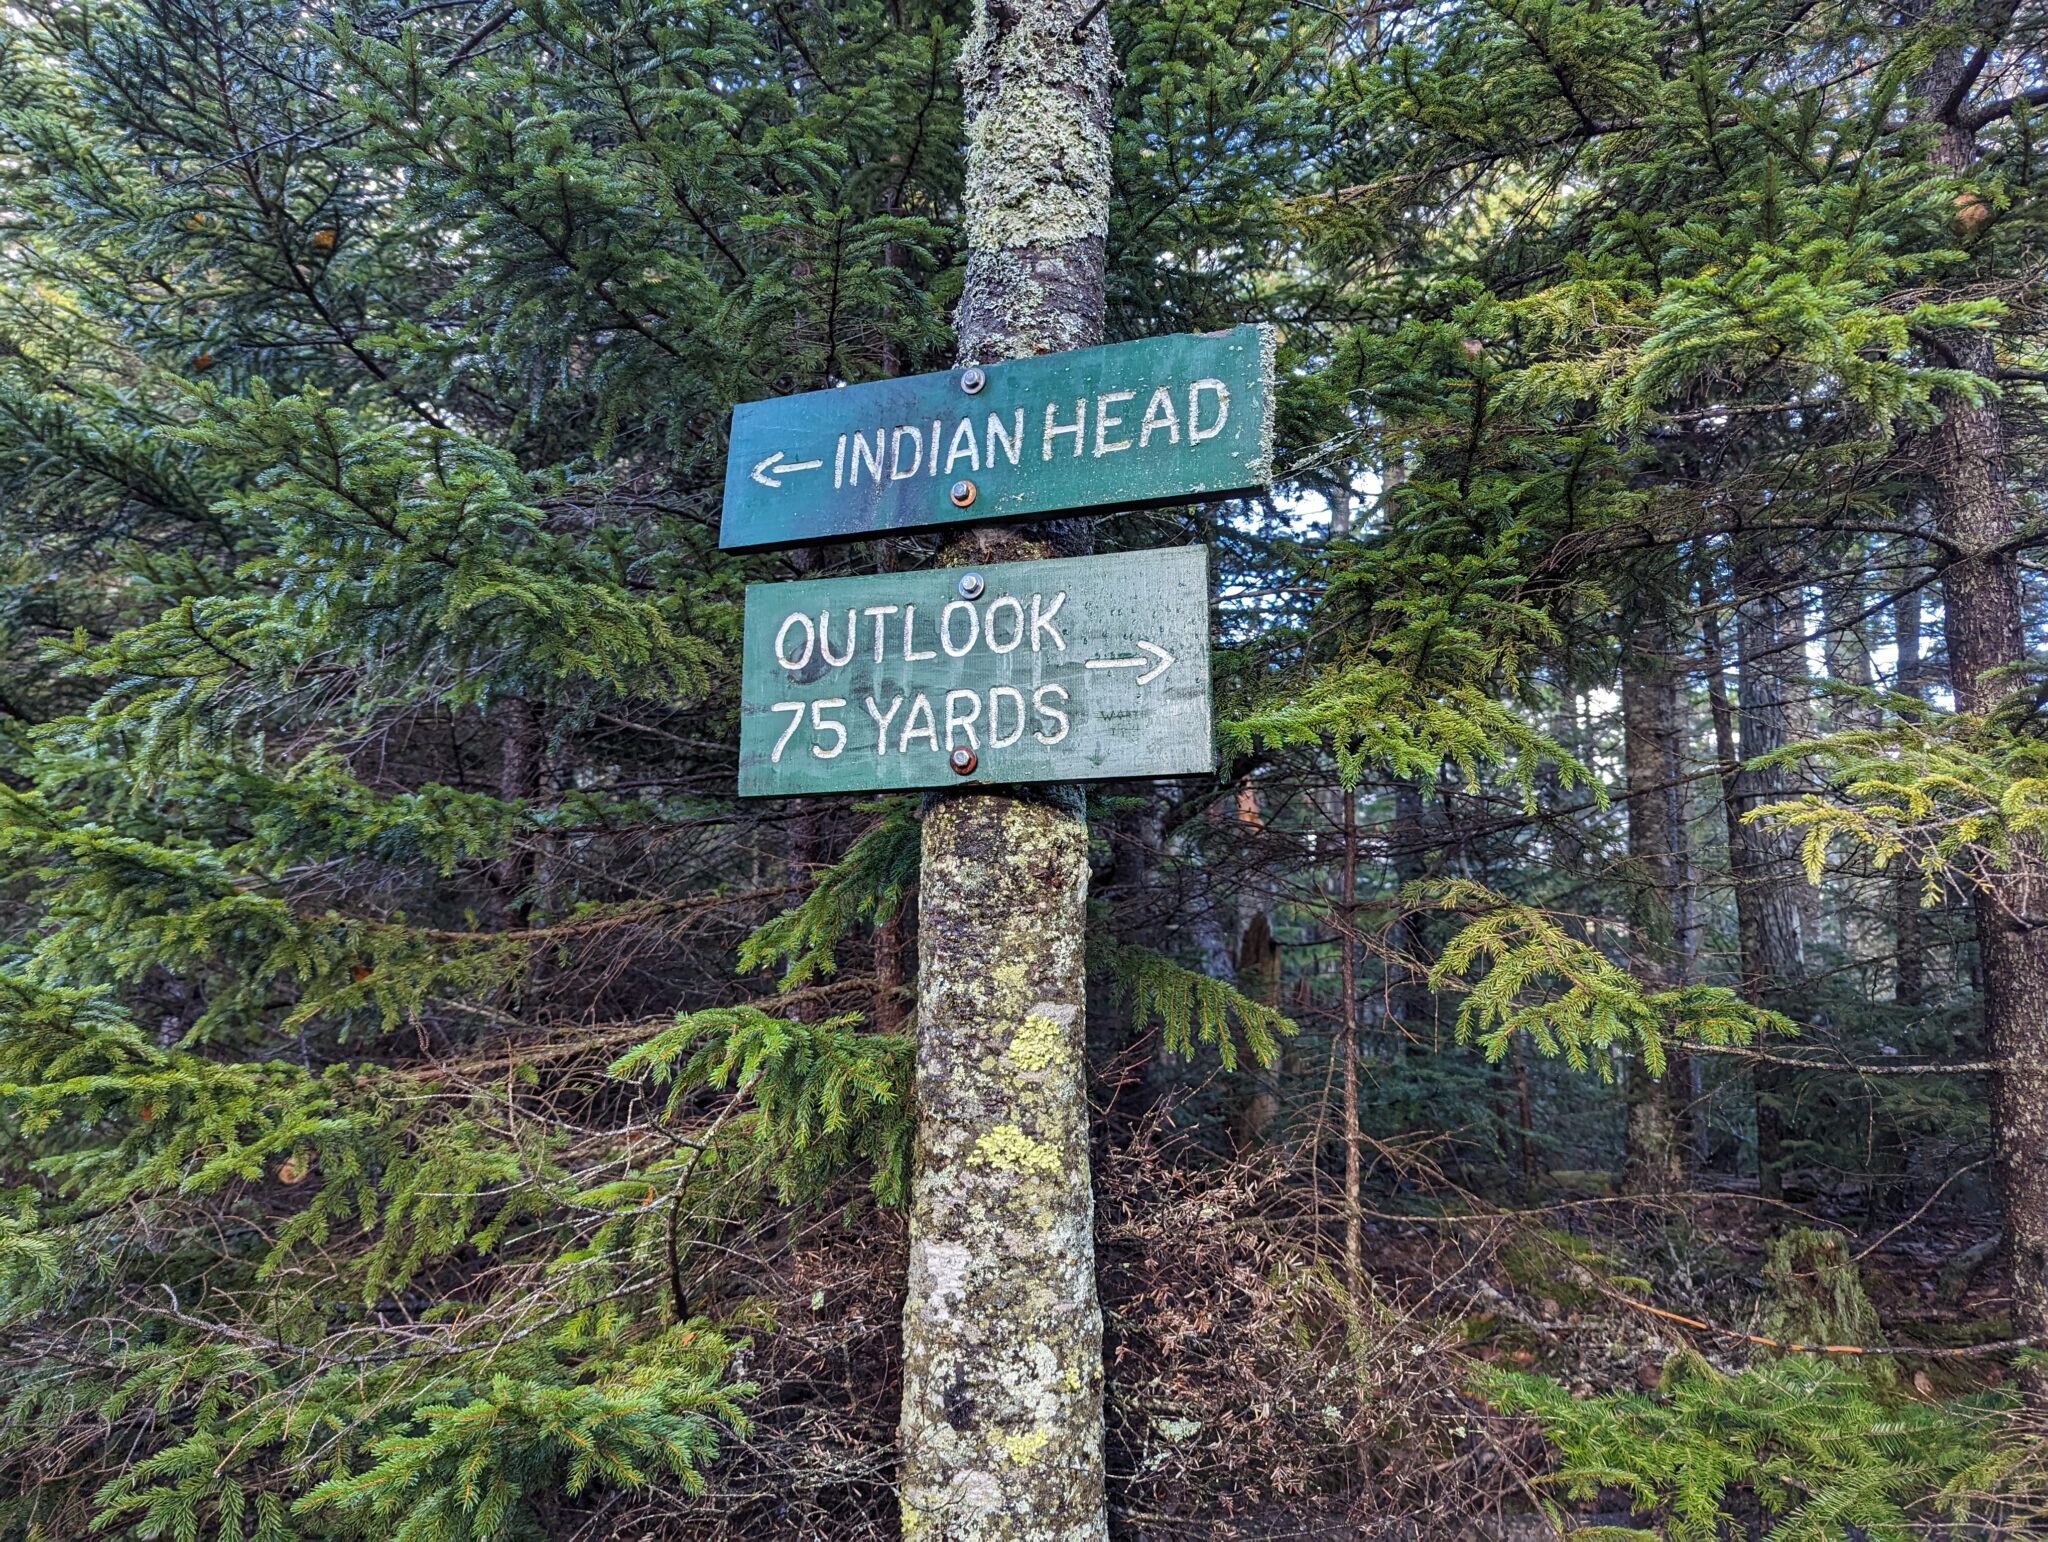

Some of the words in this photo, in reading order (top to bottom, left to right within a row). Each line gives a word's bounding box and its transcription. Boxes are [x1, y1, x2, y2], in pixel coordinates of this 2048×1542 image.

[834, 408, 1025, 488] INDIAN
[1042, 378, 1230, 460] HEAD
[774, 591, 1066, 670] OUTLOOK
[770, 699, 847, 763] 75
[865, 683, 1070, 755] YARDS
